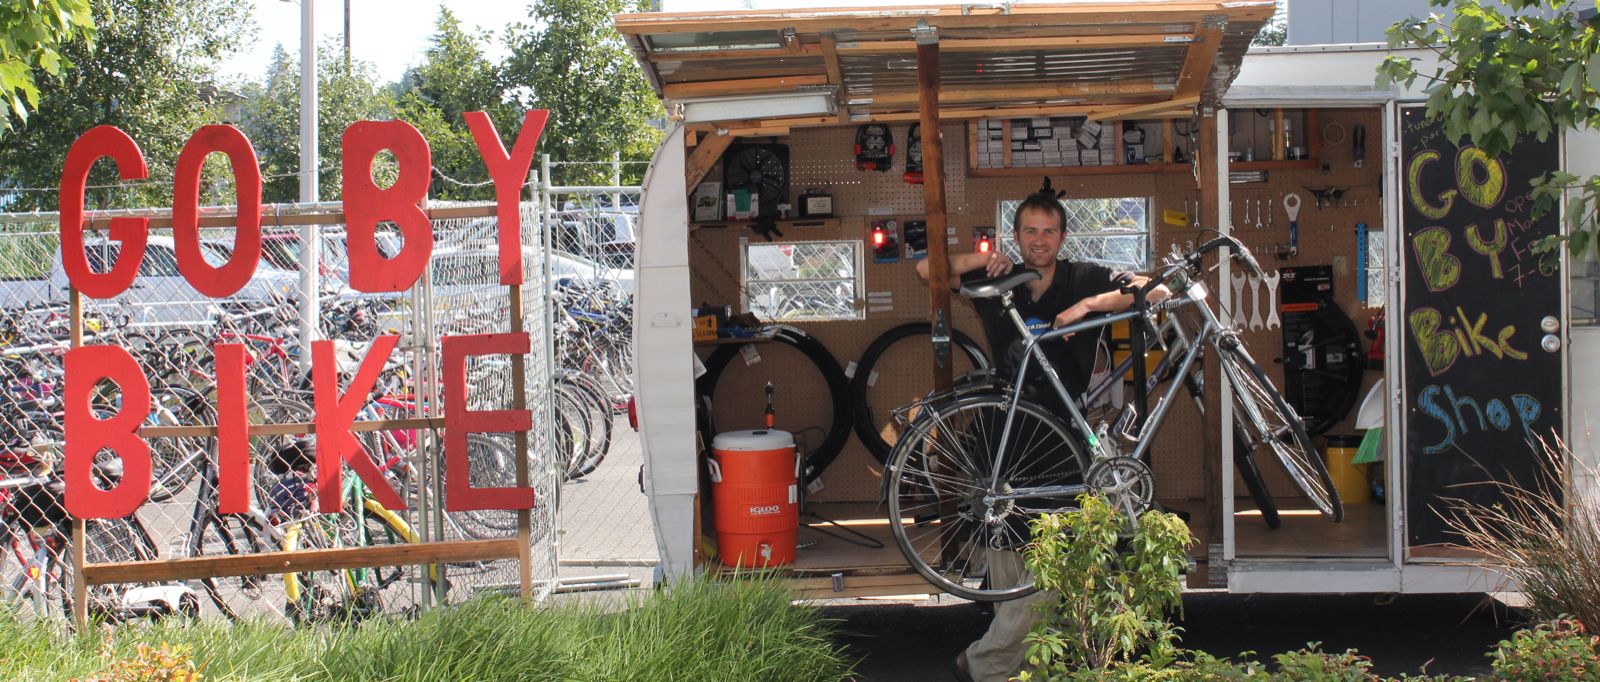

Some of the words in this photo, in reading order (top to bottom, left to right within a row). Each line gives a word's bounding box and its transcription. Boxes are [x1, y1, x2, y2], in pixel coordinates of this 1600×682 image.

[60, 124, 262, 299] GO
[342, 109, 549, 293] BY
[1407, 145, 1507, 220] GO
[1412, 218, 1508, 292] BY
[63, 332, 535, 519] BIKE
[1417, 384, 1542, 455] Shop
[750, 505, 779, 513] IGLOO
